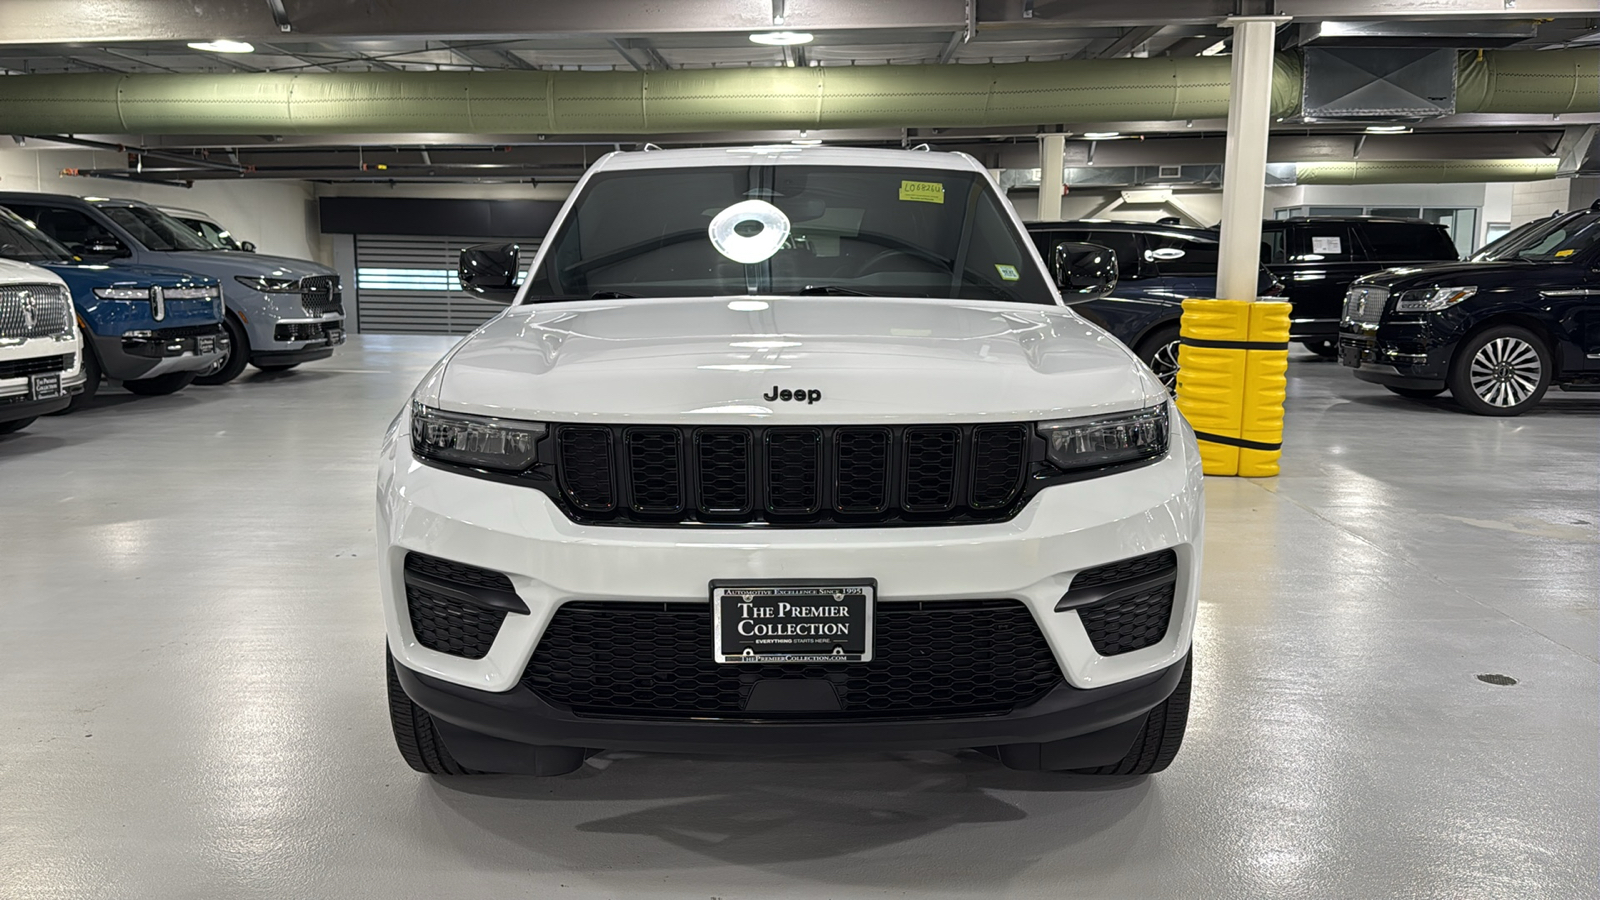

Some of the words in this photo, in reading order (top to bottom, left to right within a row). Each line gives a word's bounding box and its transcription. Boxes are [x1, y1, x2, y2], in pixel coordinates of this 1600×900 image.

[763, 385, 822, 405] Jeep
[737, 602, 775, 619] THE
[777, 602, 850, 618] PREMIER
[737, 619, 850, 636] COLLECTION
